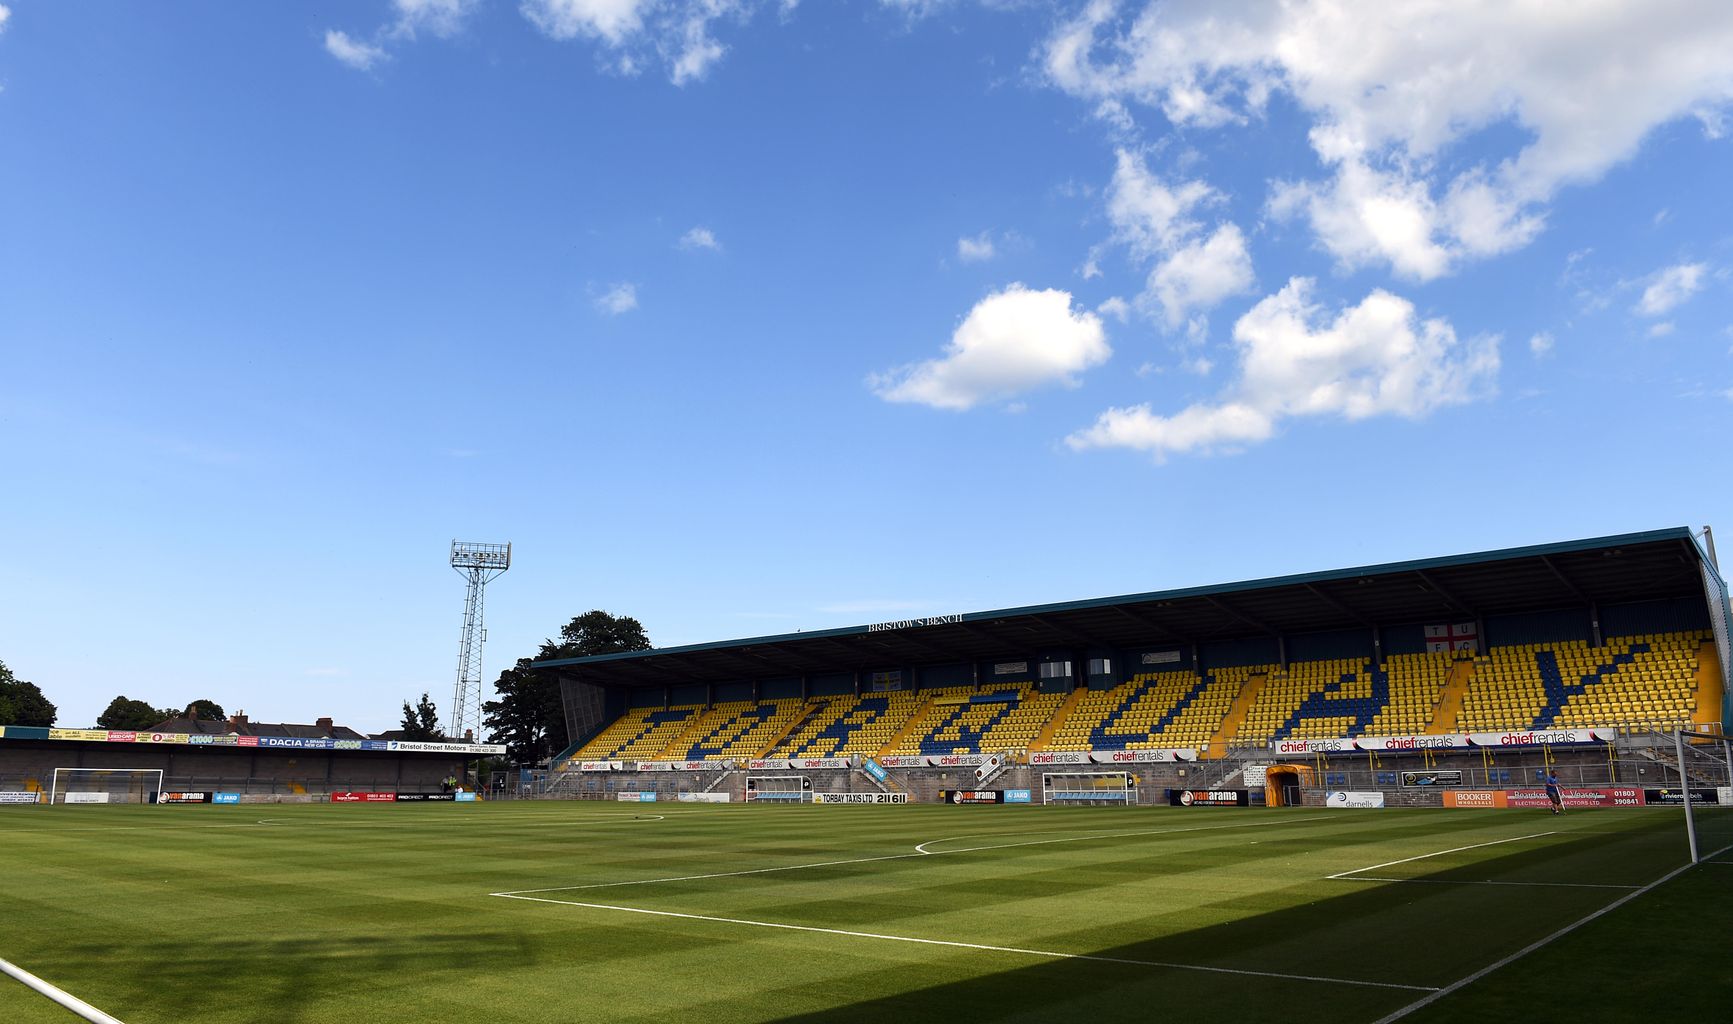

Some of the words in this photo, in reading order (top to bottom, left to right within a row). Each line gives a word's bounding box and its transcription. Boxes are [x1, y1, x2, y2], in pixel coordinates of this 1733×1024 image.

[868, 618, 924, 632] BRISTOW'S
[926, 613, 963, 626] BENCH
[1462, 624, 1468, 633] U
[1386, 736, 1454, 749] chiefrentals
[1501, 730, 1576, 745] chiefrentals
[1280, 740, 1341, 752] chiefrentals
[940, 755, 983, 765] chiefrentals
[1033, 752, 1080, 763] chiefrentals
[1113, 750, 1164, 761] chiefrentals
[750, 759, 783, 768] chiefrentals
[805, 759, 840, 767] chiefrentals
[881, 756, 920, 766] chiefrentals
[169, 792, 204, 800] vanarama
[823, 794, 844, 803] TORBAY
[845, 794, 862, 803] TAXIS
[862, 794, 873, 803] LTD
[962, 791, 996, 800] vanarama
[1193, 791, 1237, 801] vanarama
[1457, 793, 1492, 801] BOOKER
